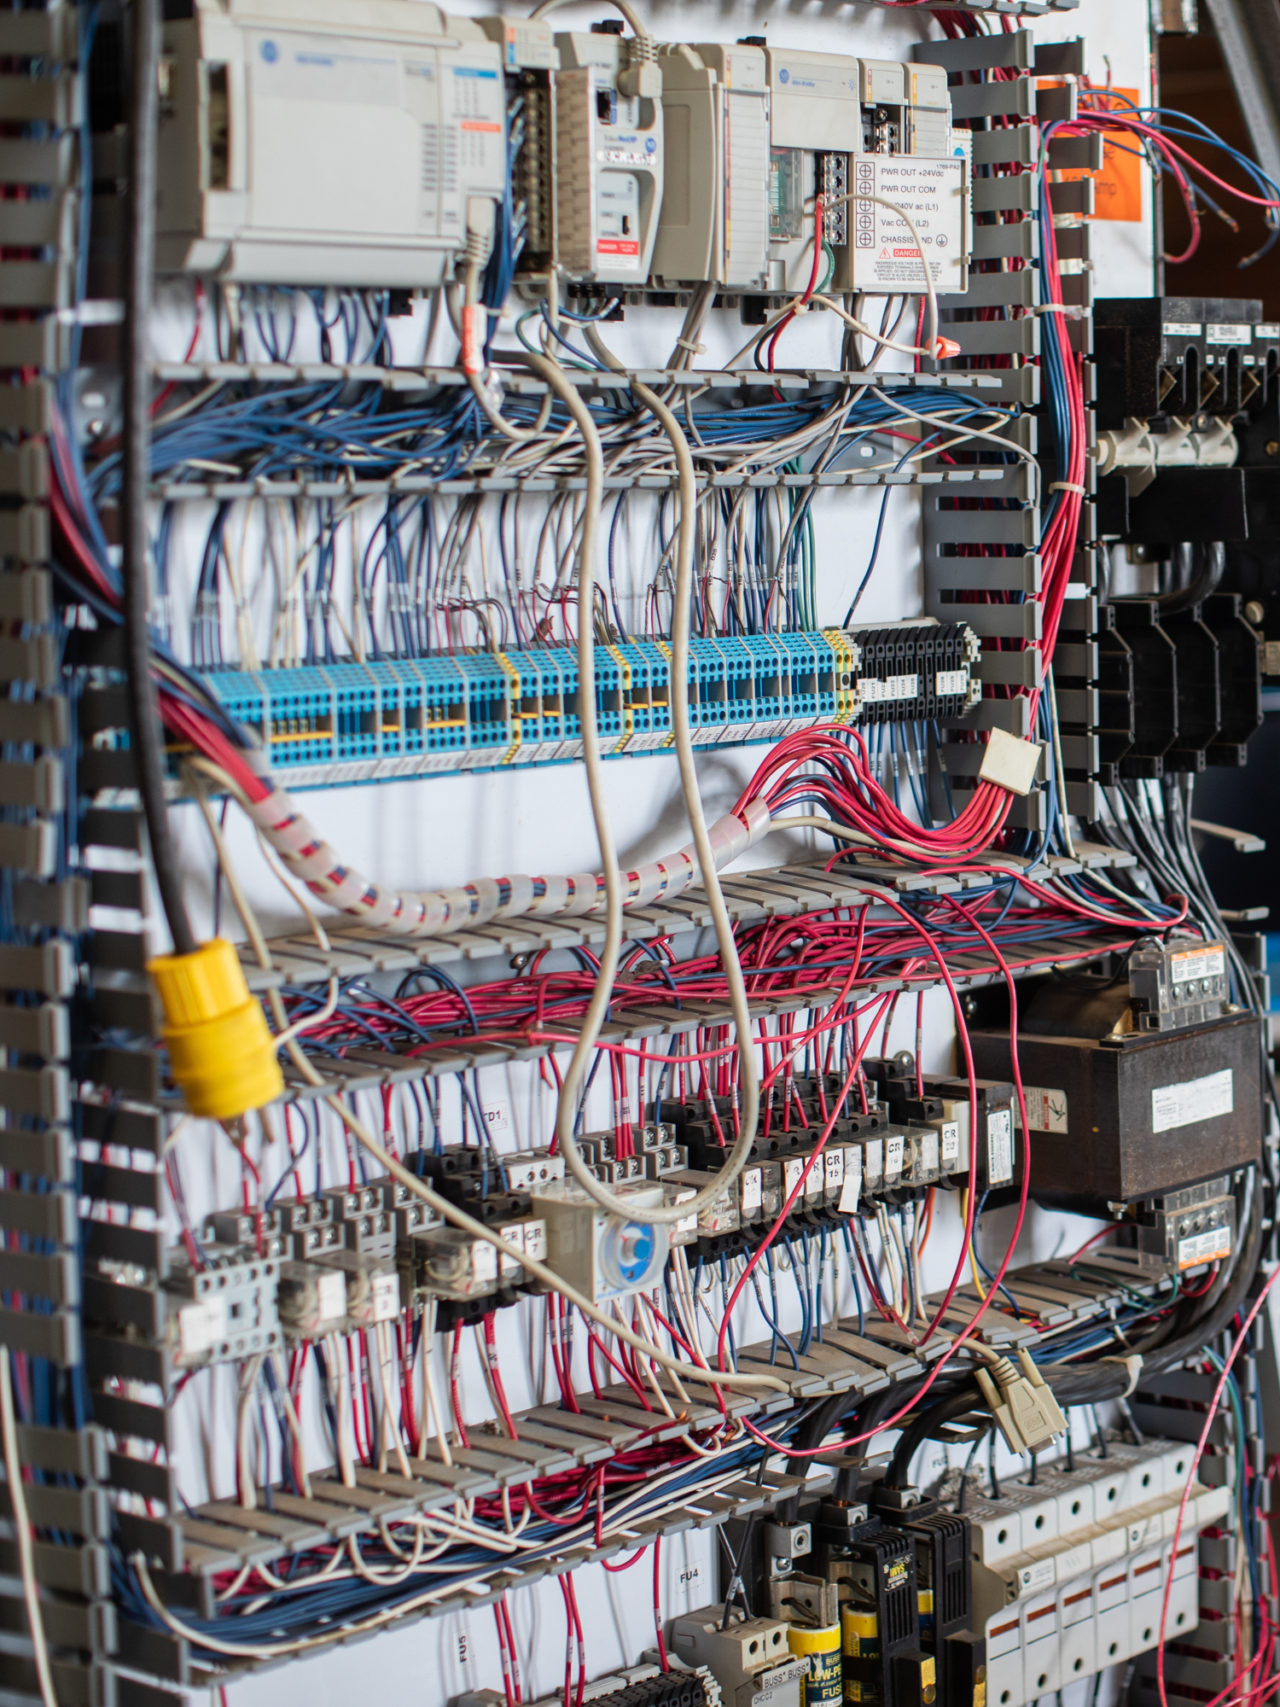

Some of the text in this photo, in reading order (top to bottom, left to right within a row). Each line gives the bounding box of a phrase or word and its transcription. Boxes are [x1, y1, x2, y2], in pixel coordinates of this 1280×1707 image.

[881, 168, 944, 177] PWR OUT +24Vdc
[900, 185, 916, 193] OUT
[925, 203, 939, 211] (L1)
[881, 219, 930, 228] Vac CO (L2)
[881, 235, 914, 244] CHASSIS
[888, 1142, 900, 1153] CR
[827, 1155, 841, 1166] CR
[680, 1567, 699, 1584] FU4
